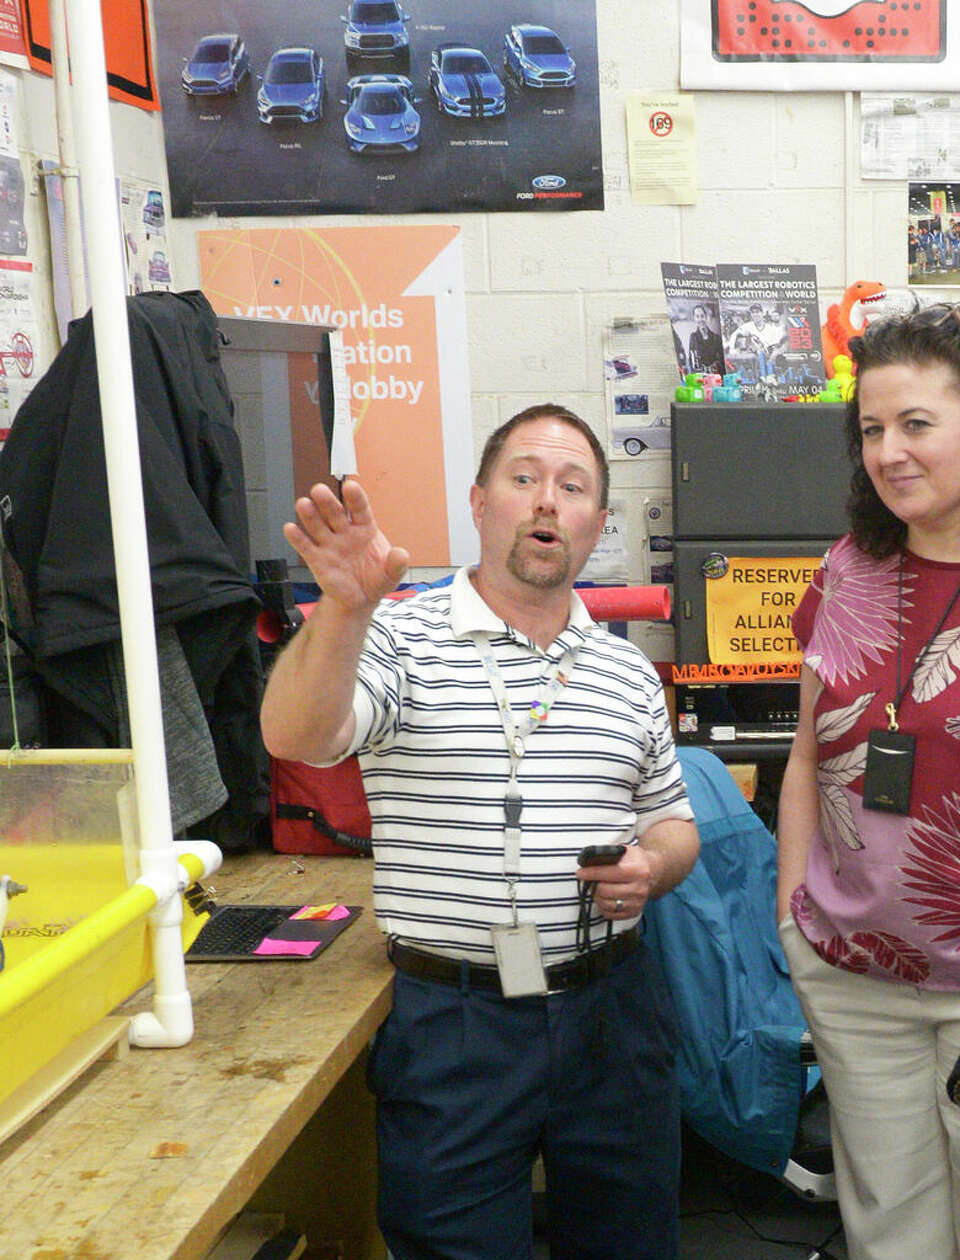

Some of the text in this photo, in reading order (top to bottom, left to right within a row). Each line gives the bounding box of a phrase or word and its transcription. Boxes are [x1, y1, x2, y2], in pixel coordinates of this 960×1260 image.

[719, 280, 815, 290] THE LARGEST ROBOTICS
[720, 290, 816, 299] COMPETITION WORLD
[302, 303, 404, 328] Worlds
[761, 592, 796, 606] FOR
[735, 614, 793, 629] ALLIA
